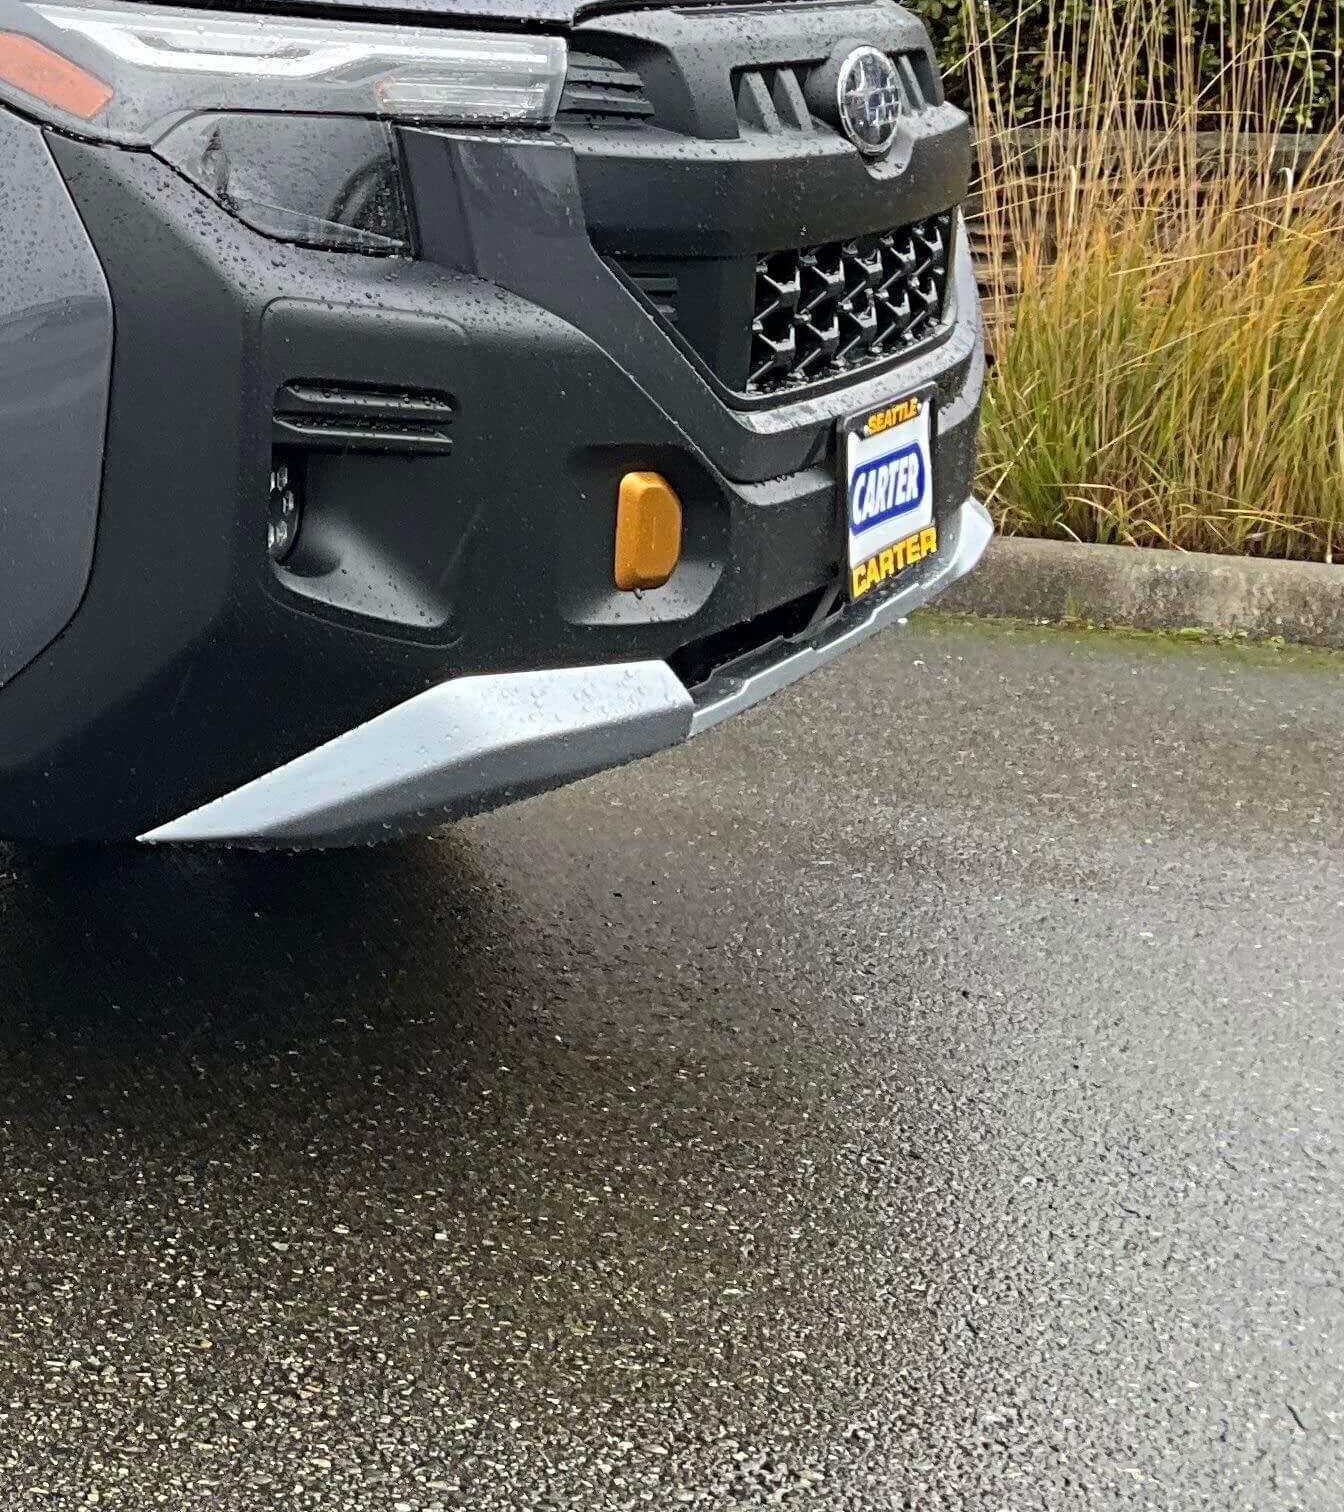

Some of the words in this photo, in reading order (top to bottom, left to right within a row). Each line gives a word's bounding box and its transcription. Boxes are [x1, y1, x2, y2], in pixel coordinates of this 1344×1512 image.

[867, 396, 919, 435] SEATTLE
[852, 451, 920, 526] CARTER
[852, 526, 938, 599] CARTER
